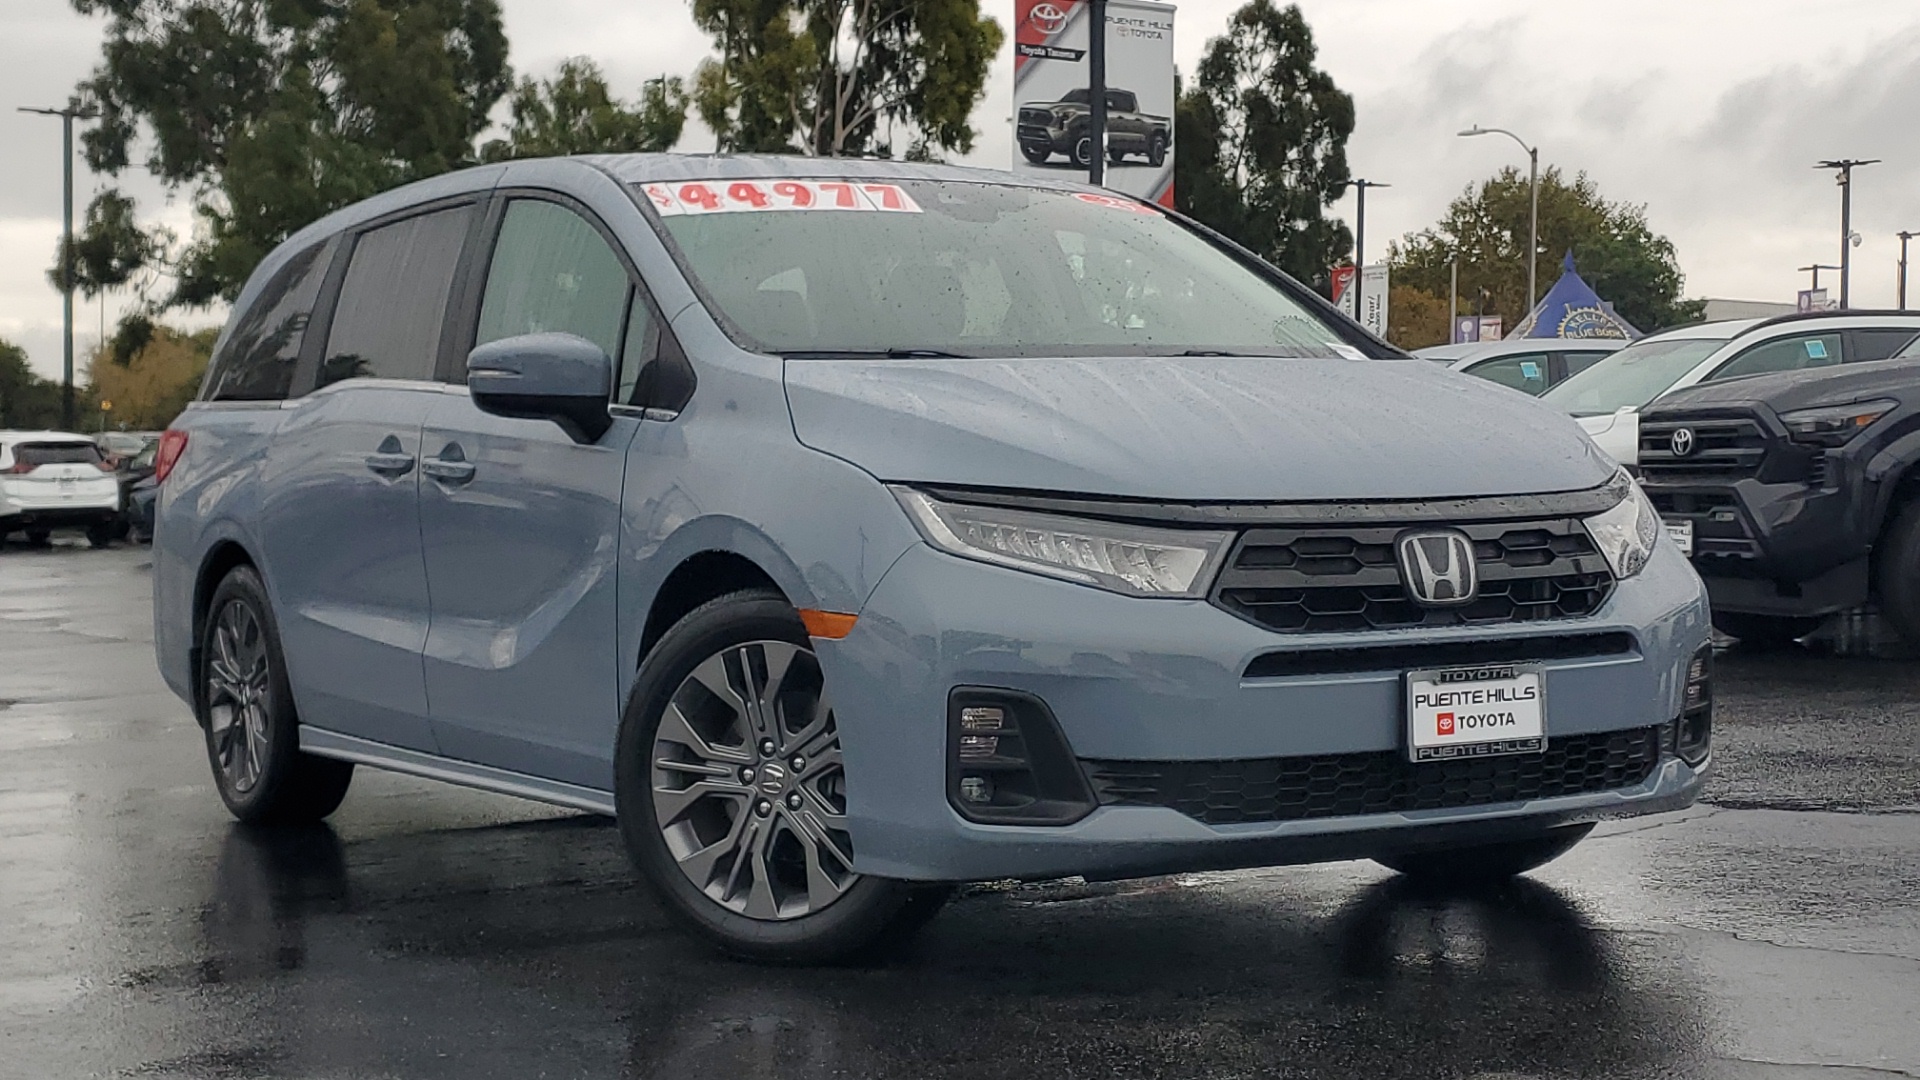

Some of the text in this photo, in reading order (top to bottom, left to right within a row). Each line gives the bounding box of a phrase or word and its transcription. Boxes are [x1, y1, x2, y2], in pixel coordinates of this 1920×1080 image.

[1104, 16, 1172, 31] PUENTE HILLS
[1130, 28, 1163, 39] TOYOTA
[1442, 667, 1512, 682] TOYOTA
[1415, 686, 1536, 709] PUENTE HILLS
[1458, 712, 1516, 730] TOYOTA
[1418, 739, 1540, 759] PUENTE HILLS
